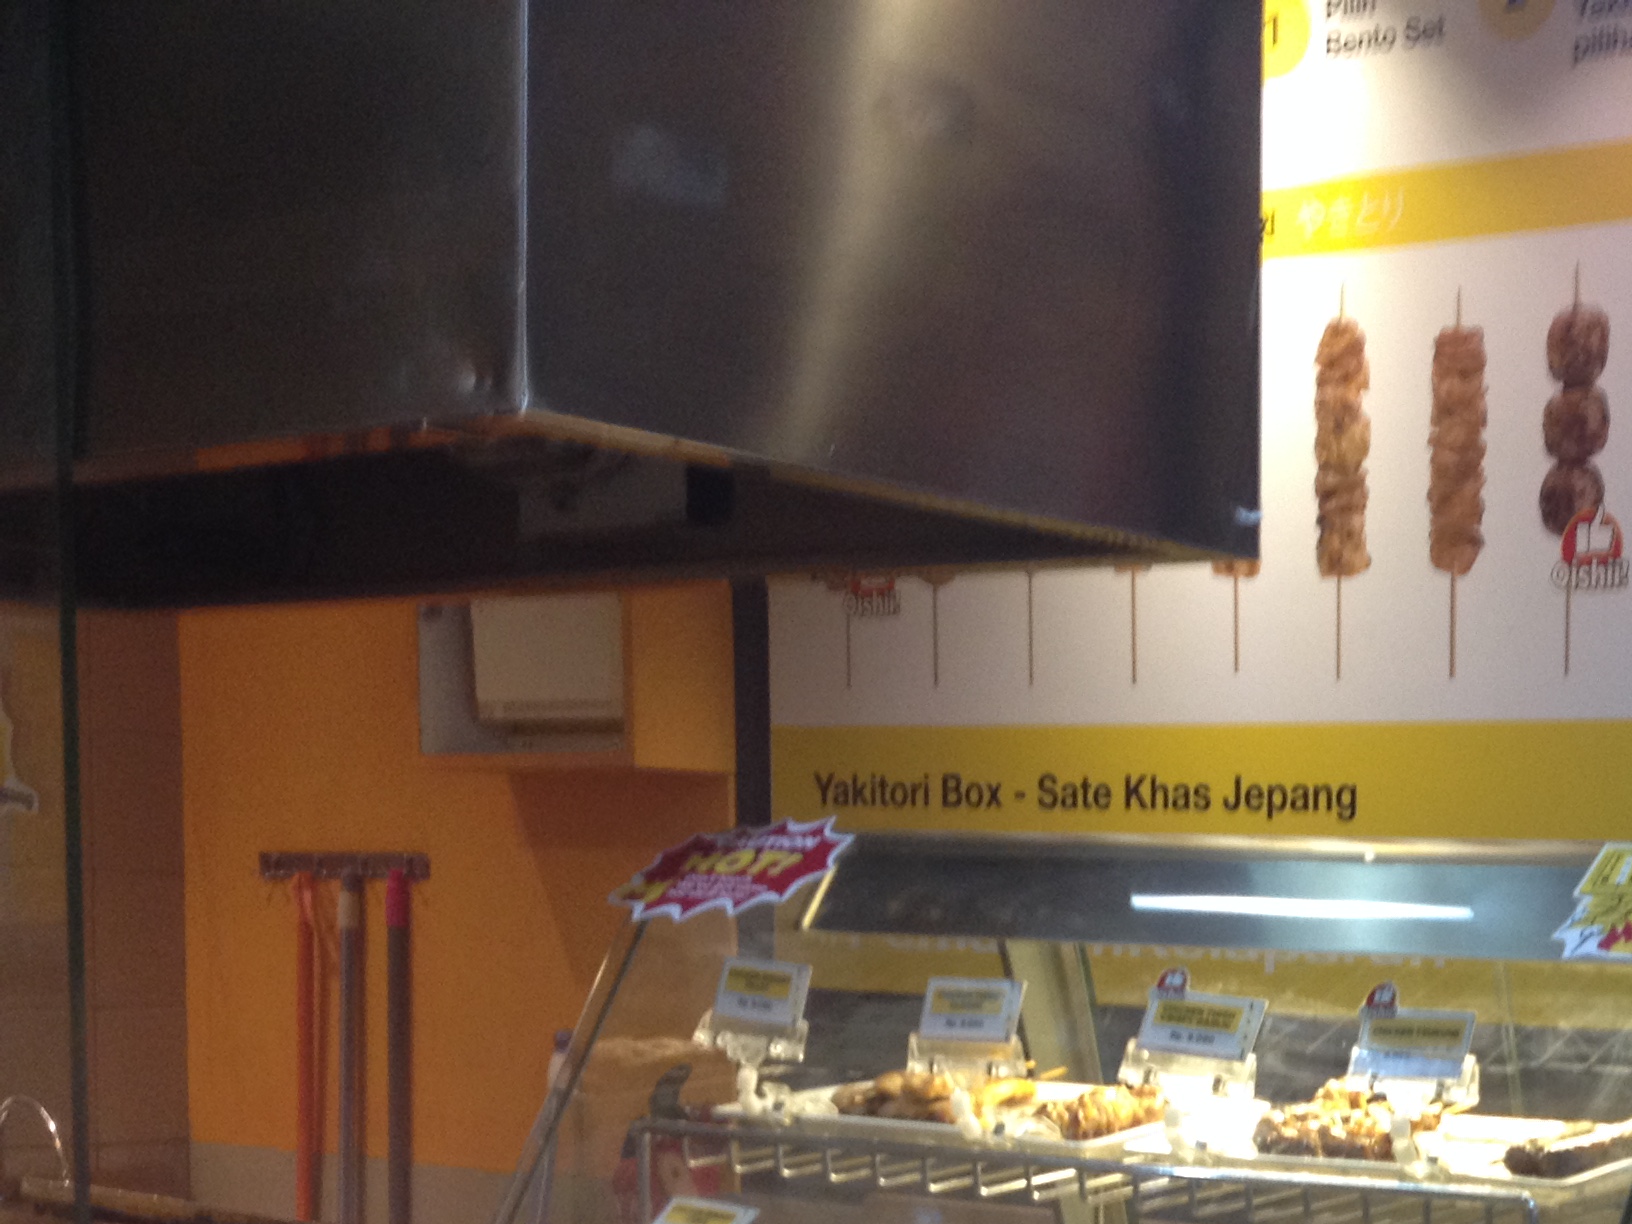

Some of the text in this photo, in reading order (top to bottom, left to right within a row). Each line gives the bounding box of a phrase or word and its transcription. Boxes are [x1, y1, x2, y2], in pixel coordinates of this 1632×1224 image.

[813, 771, 930, 809] Yakitori
[941, 772, 1002, 809] Box
[1036, 773, 1112, 812] Sate
[1124, 773, 1211, 812] Khas
[1222, 774, 1358, 822] Jepang
